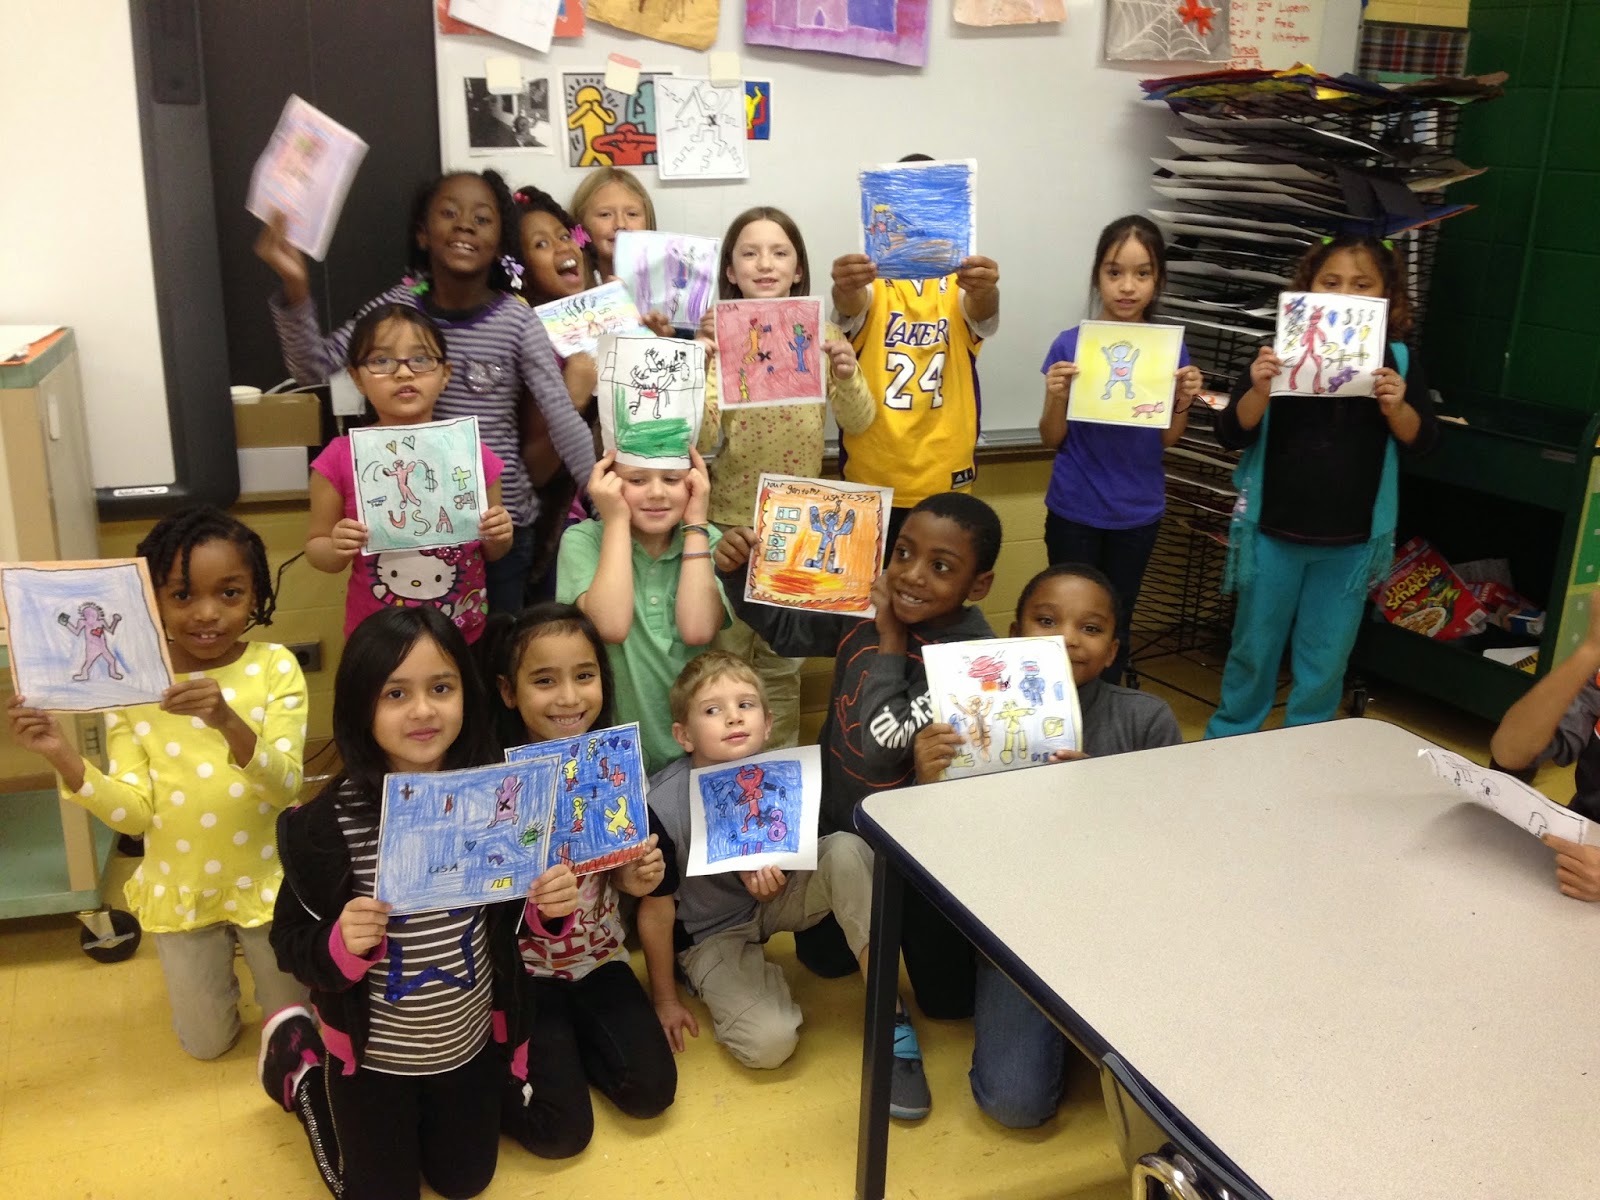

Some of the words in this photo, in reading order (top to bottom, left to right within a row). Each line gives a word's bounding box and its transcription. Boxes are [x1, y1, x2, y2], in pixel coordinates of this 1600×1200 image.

[884, 311, 950, 348] LAKER
[883, 350, 944, 411] 24
[387, 505, 454, 537] USA
[428, 862, 458, 874] USA
